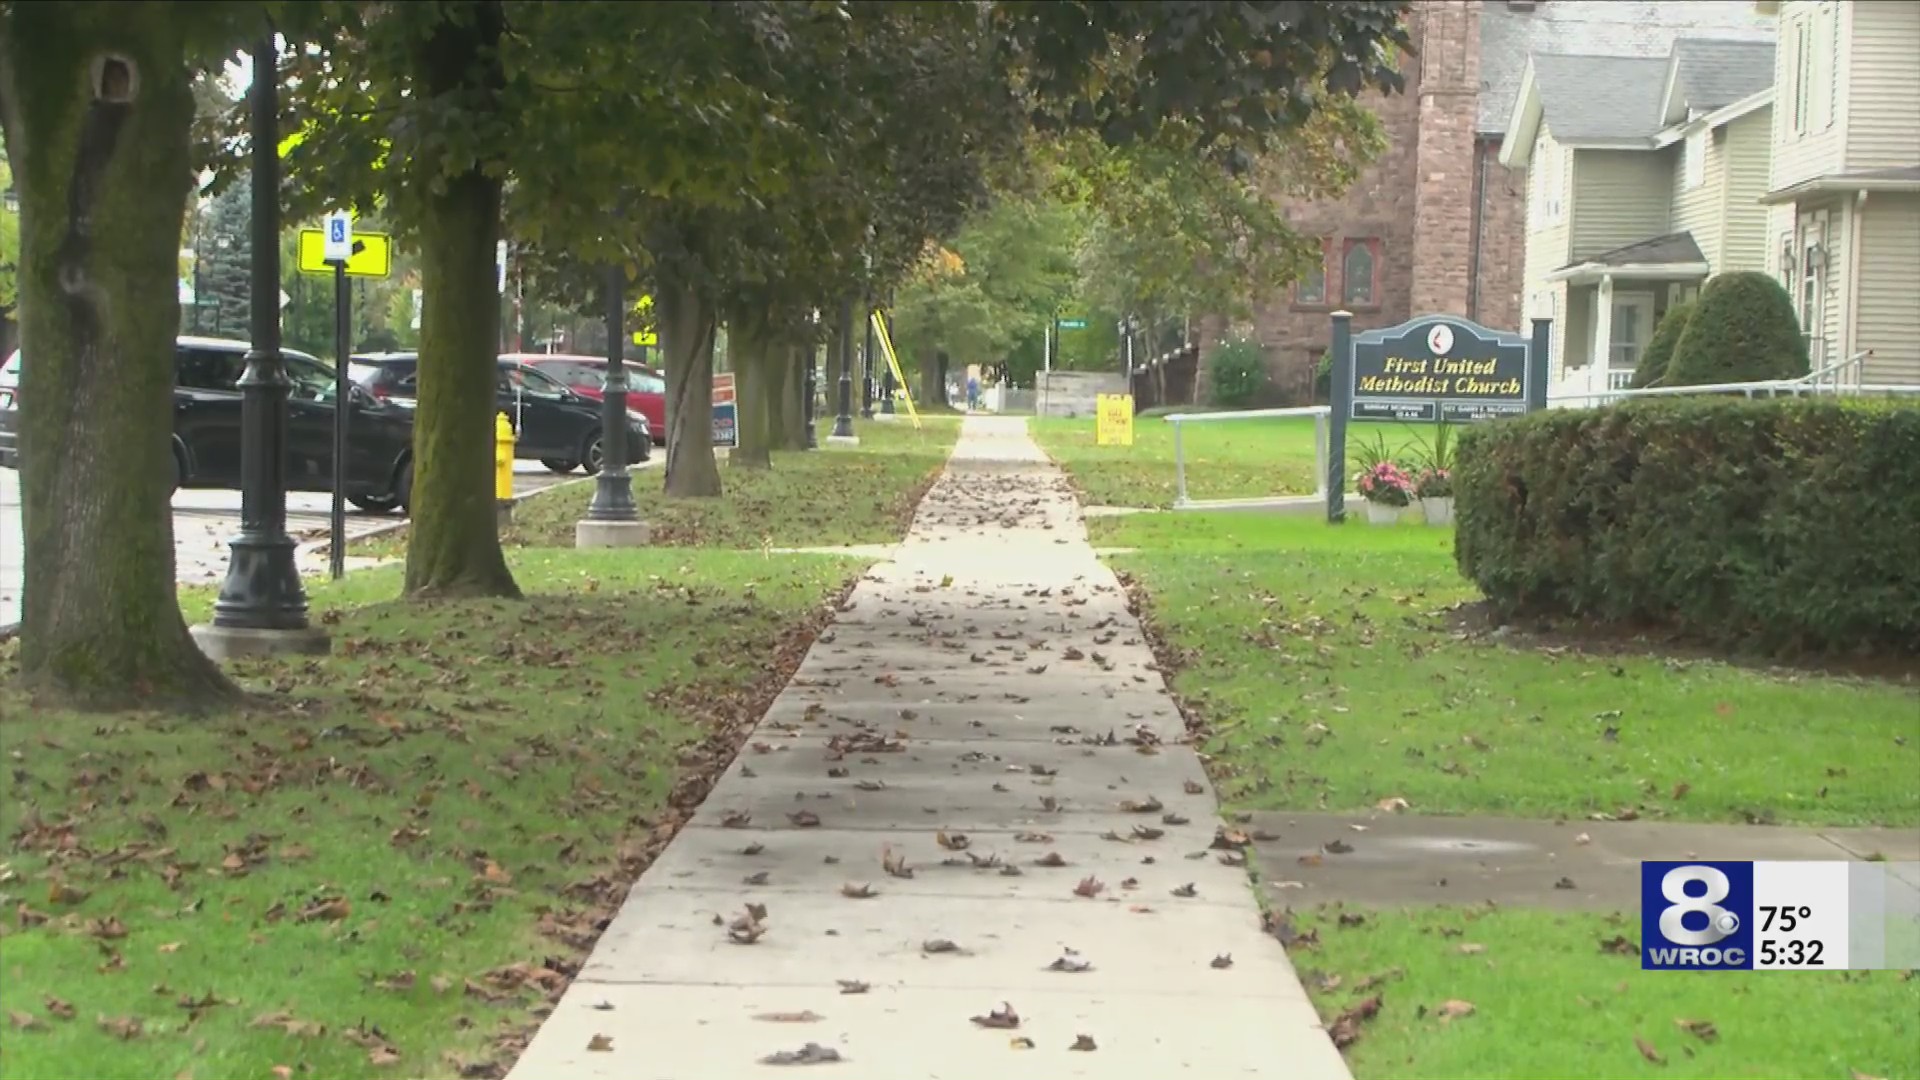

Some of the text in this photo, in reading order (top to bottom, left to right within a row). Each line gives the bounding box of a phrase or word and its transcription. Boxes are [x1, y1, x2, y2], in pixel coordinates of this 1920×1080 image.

[1384, 357, 1497, 375] First United
[1359, 375, 1521, 394] Methodist Church
